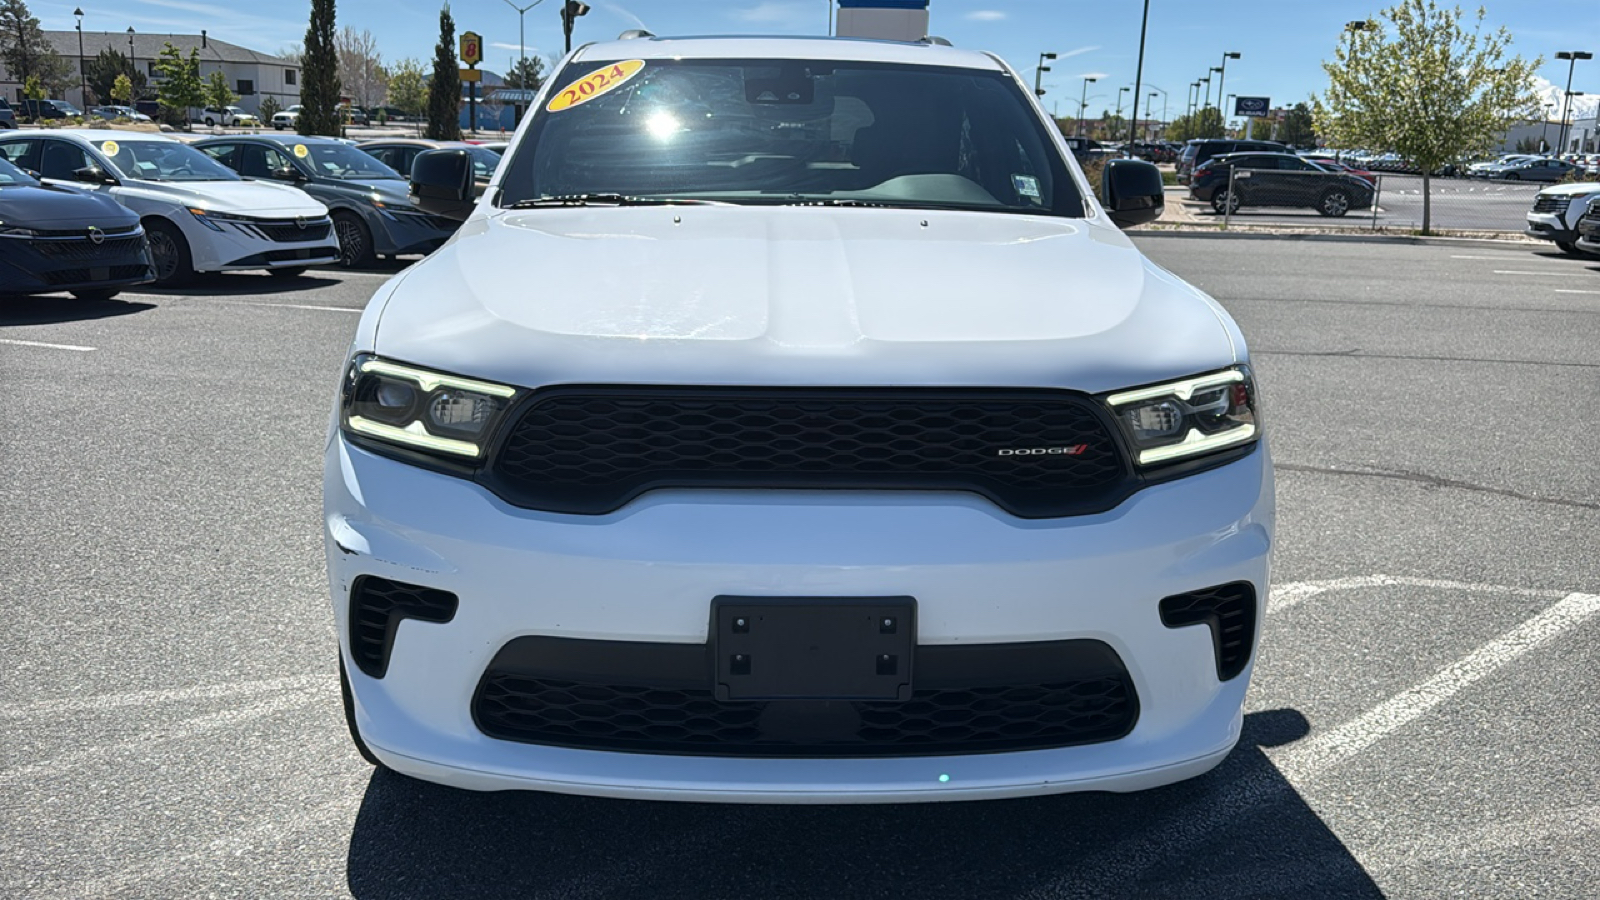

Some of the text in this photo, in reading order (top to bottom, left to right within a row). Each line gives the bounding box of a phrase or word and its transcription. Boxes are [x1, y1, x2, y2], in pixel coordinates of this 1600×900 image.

[465, 43, 476, 58] 8
[562, 64, 625, 106] 2024
[998, 446, 1077, 456] DODGE
